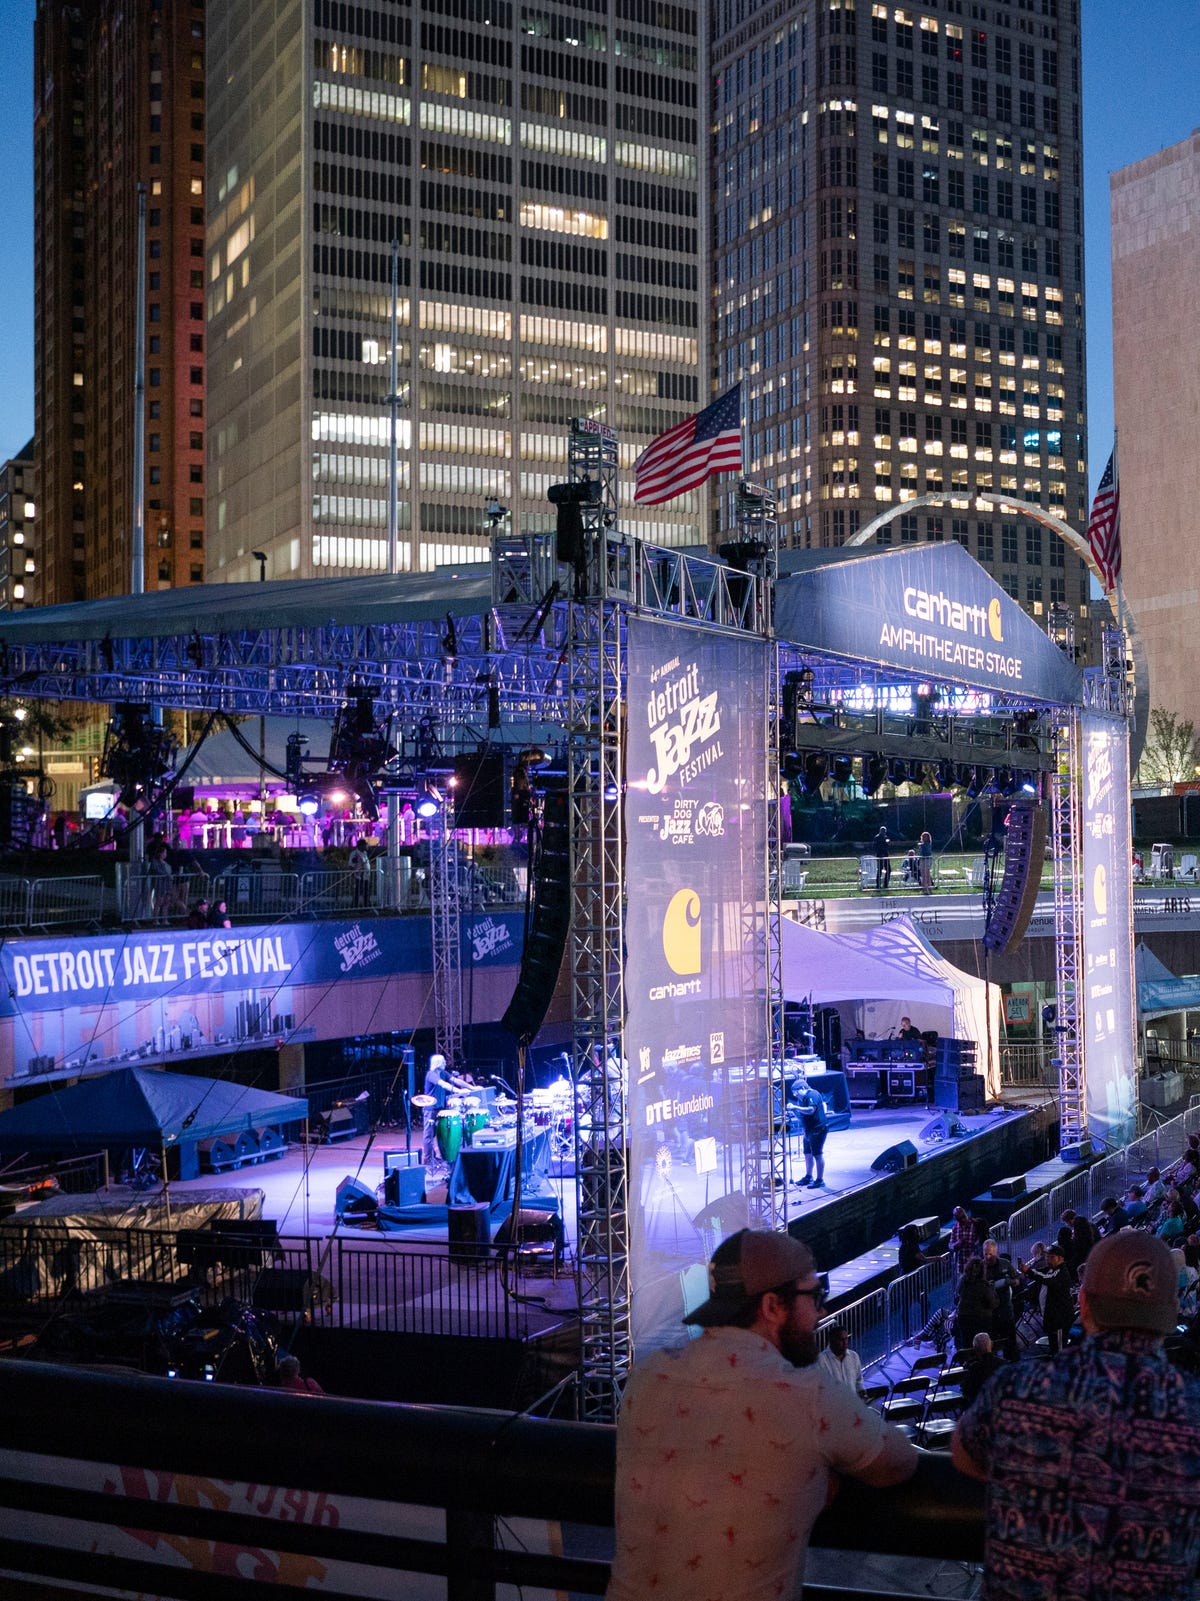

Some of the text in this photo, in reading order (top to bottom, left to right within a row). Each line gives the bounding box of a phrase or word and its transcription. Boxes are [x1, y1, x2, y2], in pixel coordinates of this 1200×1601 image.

[903, 587, 988, 637] carhartt
[880, 623, 1023, 679] AMPHITHEATER STAGE
[647, 662, 700, 729] detroit
[679, 741, 724, 788] FESTIVAL
[673, 809, 692, 819] DOG
[674, 800, 699, 809] DIRTY
[660, 815, 690, 840] Jazz
[672, 832, 694, 845] CAFÉ
[881, 901, 897, 909] THE
[1164, 897, 1190, 913] ARTS
[880, 910, 942, 925] KRSGE
[334, 924, 363, 950] detroit
[359, 948, 383, 968] FESTIVAL
[490, 940, 514, 957] FESTIVAL
[14, 936, 292, 997] DETROIT JAZZ FESTIVAL
[649, 979, 702, 1001] carhartt
[711, 1034, 722, 1042] FOX
[661, 1045, 702, 1063] JazzTimes
[713, 1043, 721, 1059] 2
[646, 1093, 714, 1126] DTE Foundation
